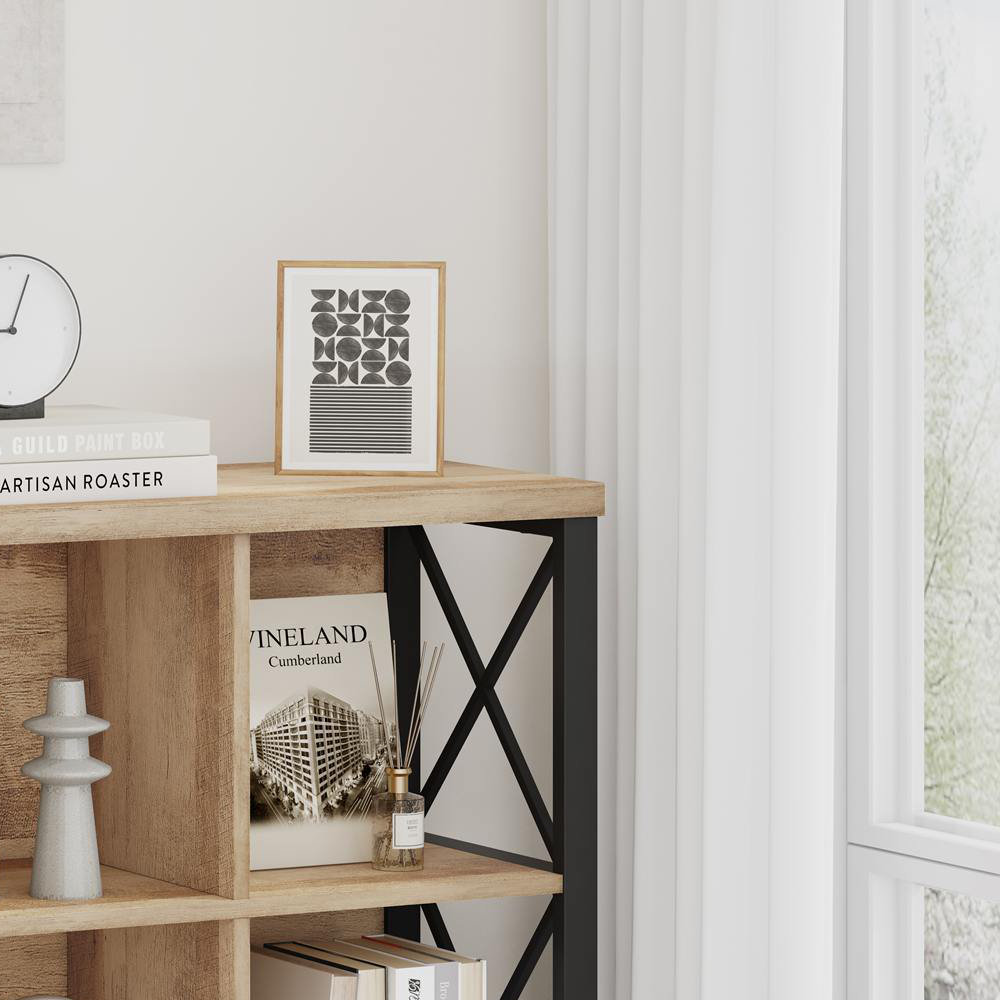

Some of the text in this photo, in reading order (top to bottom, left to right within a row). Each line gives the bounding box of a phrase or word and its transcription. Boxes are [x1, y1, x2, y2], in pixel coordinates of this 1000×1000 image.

[12, 434, 68, 455] GUILD
[76, 432, 124, 453] PAINT
[132, 431, 165, 450] BOX
[0, 475, 77, 494] ARTISAN
[83, 471, 163, 490] ROASTER
[268, 651, 342, 668] Cumberland
